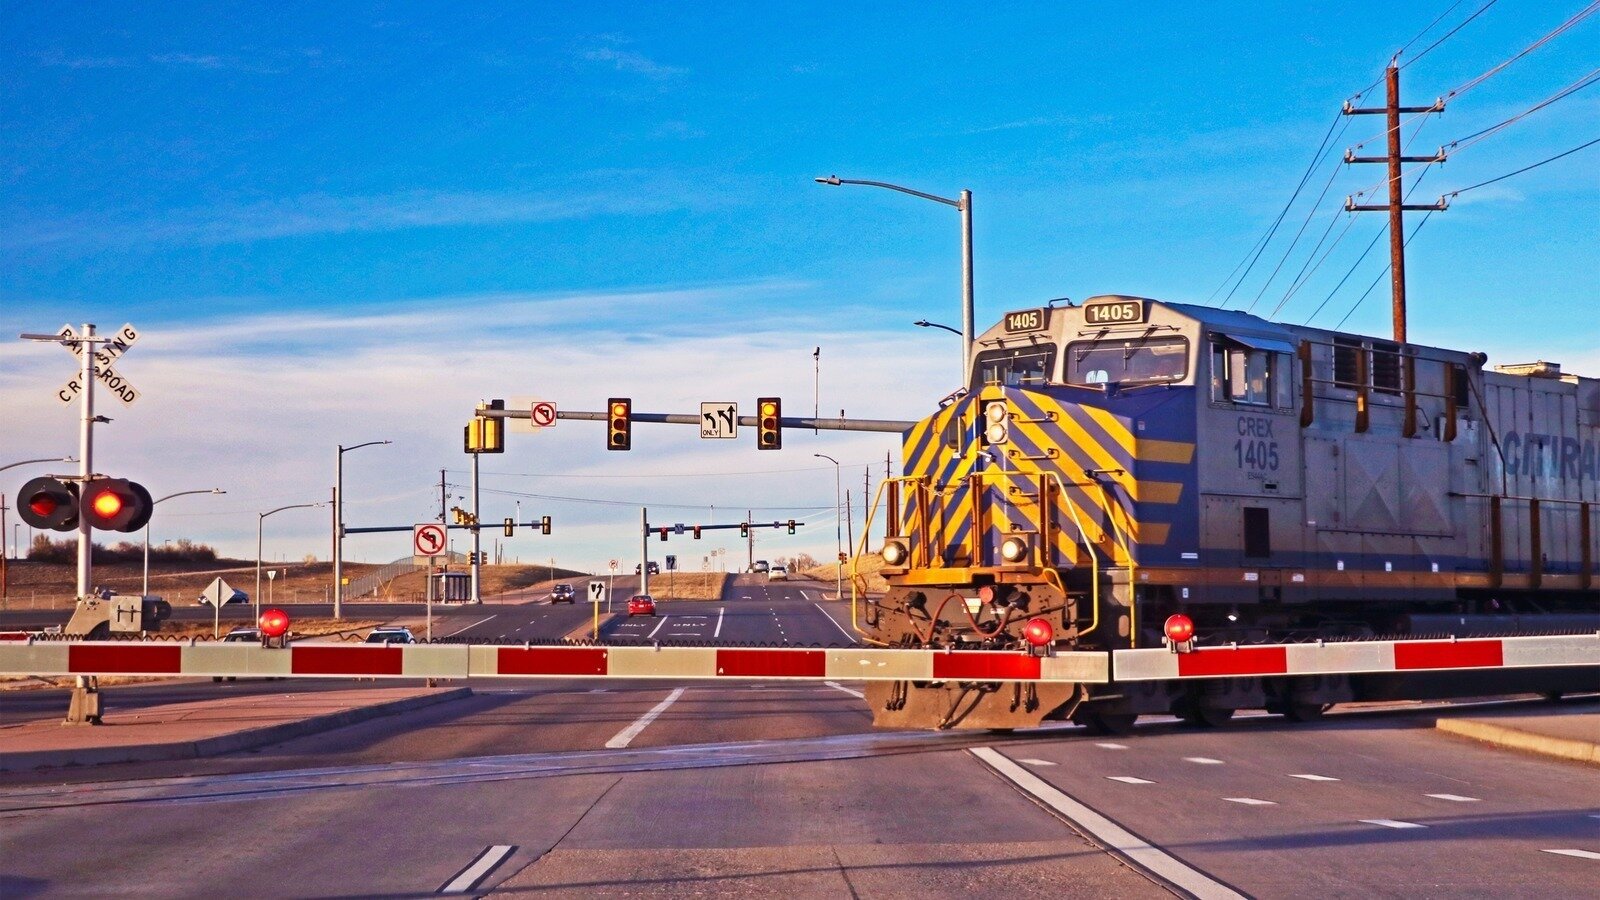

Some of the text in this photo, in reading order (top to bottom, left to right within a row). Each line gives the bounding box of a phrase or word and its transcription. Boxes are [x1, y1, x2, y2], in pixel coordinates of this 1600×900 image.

[1008, 312, 1037, 329] 1405
[1091, 304, 1134, 321] 1405
[60, 328, 135, 403] RAIROAD
[1238, 416, 1273, 438] CREX
[1234, 439, 1279, 470] 1405
